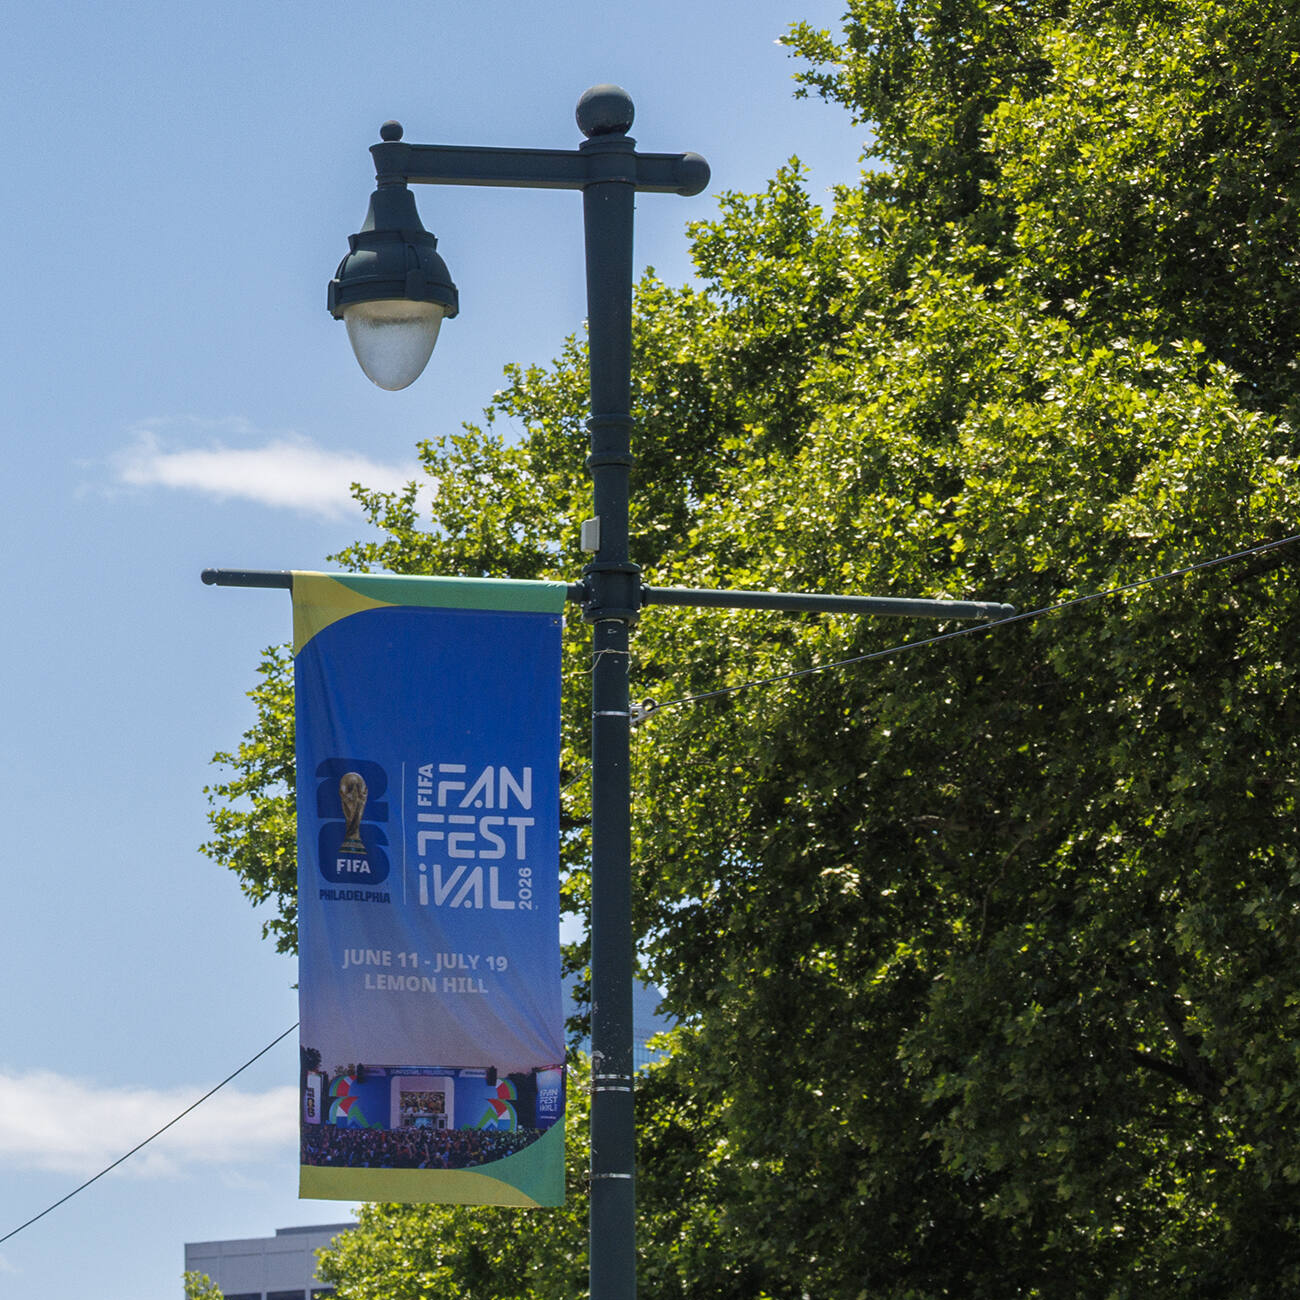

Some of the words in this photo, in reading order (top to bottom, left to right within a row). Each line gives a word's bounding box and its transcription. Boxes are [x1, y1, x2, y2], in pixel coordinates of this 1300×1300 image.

[417, 763, 434, 807] FIFA
[438, 763, 532, 810] FAN
[417, 813, 535, 860] FEST
[336, 858, 371, 874] FIFA
[319, 888, 391, 904] PHILADELPHIA
[519, 867, 533, 911] 2026
[342, 949, 391, 969] JUNE
[397, 952, 419, 967] 11
[434, 952, 480, 973] JULY
[486, 955, 508, 971] 19
[365, 974, 437, 992] LEMON
[443, 977, 488, 993] HILL
